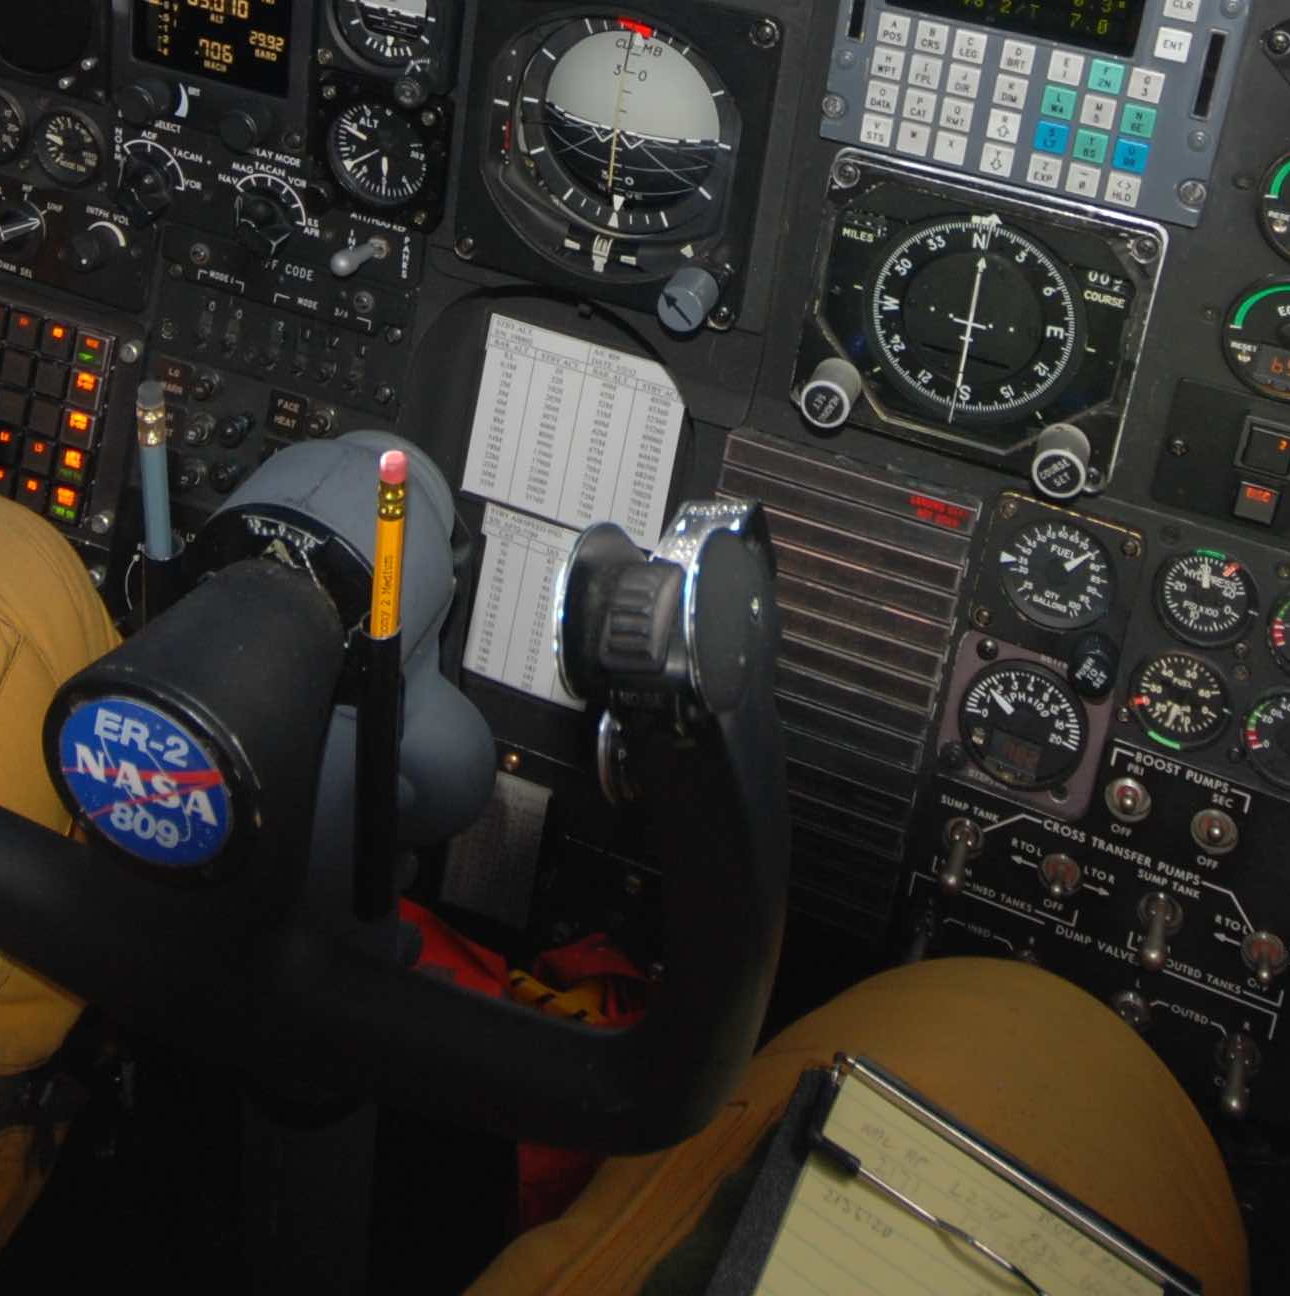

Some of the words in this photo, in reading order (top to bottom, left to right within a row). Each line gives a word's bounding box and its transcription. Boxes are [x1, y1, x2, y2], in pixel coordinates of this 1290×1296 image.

[209, 12, 226, 25] ALT
[882, 30, 903, 43] POS
[920, 37, 941, 51] CRS
[958, 47, 978, 60] LEG
[1162, 39, 1184, 52] ENT
[203, 59, 229, 74] MACH
[877, 64, 897, 77] WPT
[914, 73, 933, 85] FPL
[870, 96, 892, 110] DATA
[909, 107, 927, 119] CAT
[358, 115, 380, 129] ALT
[140, 129, 158, 141] ADF
[113, 127, 124, 162] NORM
[172, 146, 204, 164] TACAN
[275, 152, 302, 168] MODE
[231, 161, 254, 174] MAG
[254, 163, 286, 178] TACAN
[182, 178, 203, 191] VOR
[217, 172, 239, 186] NAV
[287, 175, 308, 189] VOR
[1033, 169, 1054, 184] EXP
[1111, 189, 1133, 204] HLD
[112, 212, 131, 226] VOL
[841, 226, 875, 244] MILES
[972, 231, 988, 251] N
[927, 235, 947, 252] 33
[1014, 250, 1028, 264] 3
[284, 262, 315, 283] CODE
[893, 257, 914, 277] 30
[207, 268, 231, 283] MODE
[1042, 285, 1057, 298] 6
[1083, 289, 1126, 310] COURSE
[296, 296, 320, 311] MODE
[881, 294, 901, 313] W
[1045, 324, 1065, 341] E
[890, 333, 907, 353] 24
[1230, 339, 1258, 354] RESET
[917, 368, 934, 385] 21
[1032, 361, 1050, 378] 12
[958, 384, 973, 402] S
[999, 383, 1016, 400] 15
[274, 414, 297, 429] HEAT
[1037, 458, 1069, 481] COURSE
[1052, 471, 1071, 489] SET
[1050, 543, 1076, 561] FUEL
[1173, 580, 1187, 593] 20
[1043, 588, 1061, 602] QTY
[1031, 593, 1068, 614] GALLONS
[1074, 655, 1096, 681] PUSH
[1090, 670, 1109, 689] SET
[1171, 677, 1194, 689] FUEL
[980, 707, 989, 719] 0
[93, 706, 190, 769] ER-2
[1048, 732, 1063, 745] 20
[1126, 761, 1146, 778] PRI
[1134, 750, 1183, 777] BOOST
[1185, 769, 1230, 795] PUMPS
[74, 742, 219, 828] NASA
[940, 793, 970, 812] SUMP
[973, 805, 1000, 824] TANK
[1211, 793, 1235, 810] SEC
[109, 800, 181, 850] 809
[1110, 823, 1133, 838] OFF
[1042, 818, 1088, 844] CROSS
[1091, 835, 1153, 870] TRANSFER
[1157, 860, 1203, 886] PUMPS
[1196, 854, 1220, 870] OFF
[1136, 868, 1168, 886] SUMP
[1172, 882, 1203, 901] TANK
[972, 883, 997, 899] INBD
[1000, 892, 1034, 913] TANKS
[1042, 898, 1064, 912] OFF
[967, 923, 991, 939] INBD
[1054, 924, 1093, 945] DUMP
[1165, 957, 1203, 979] OUTBD
[1205, 973, 1243, 996] TANKS
[1170, 1003, 1210, 1026] OUTBD
